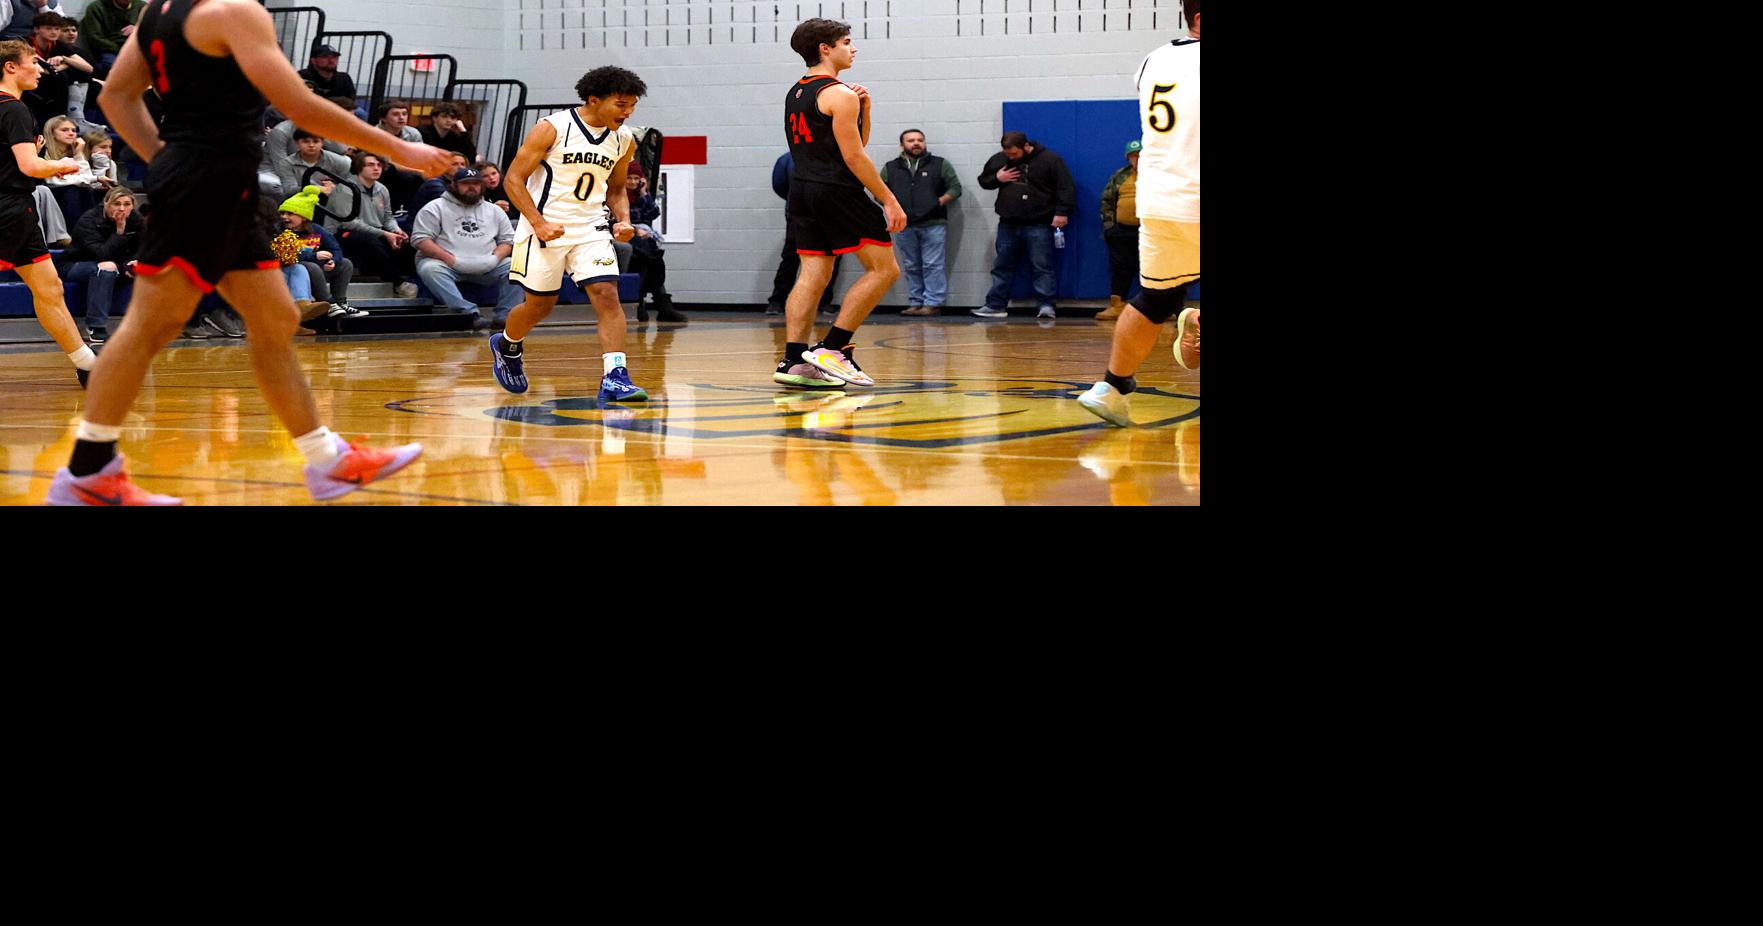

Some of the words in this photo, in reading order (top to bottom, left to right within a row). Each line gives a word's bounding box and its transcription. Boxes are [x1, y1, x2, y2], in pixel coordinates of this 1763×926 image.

[1148, 83, 1176, 134] 5
[789, 111, 813, 145] 24
[562, 151, 615, 170] EAGLES
[574, 172, 594, 201] 0
